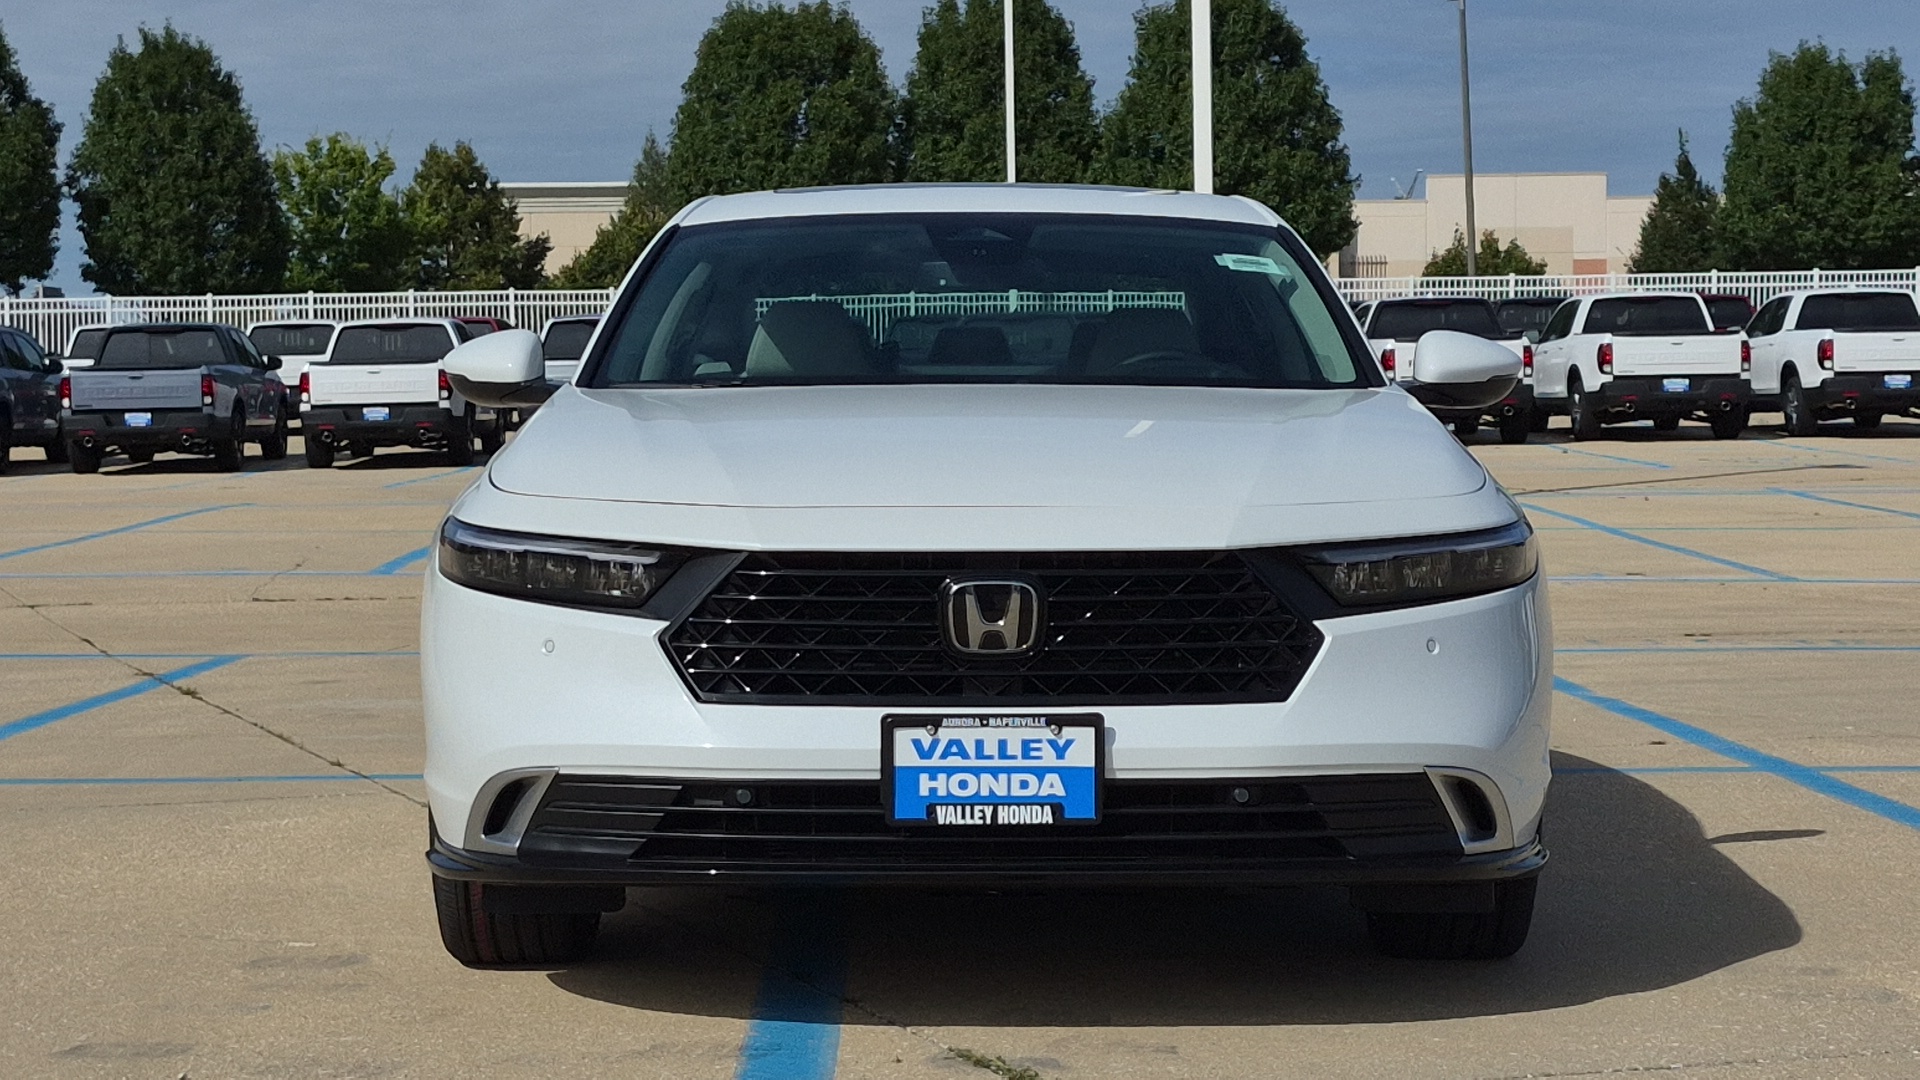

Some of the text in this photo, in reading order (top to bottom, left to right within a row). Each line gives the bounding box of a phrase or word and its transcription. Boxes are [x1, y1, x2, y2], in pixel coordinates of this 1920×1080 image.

[941, 717, 1047, 727] AURORA NAPERVILLE
[910, 738, 1077, 761] VALLEY
[918, 773, 1067, 797] HONDA
[936, 805, 1054, 825] VALLEY HONDA
